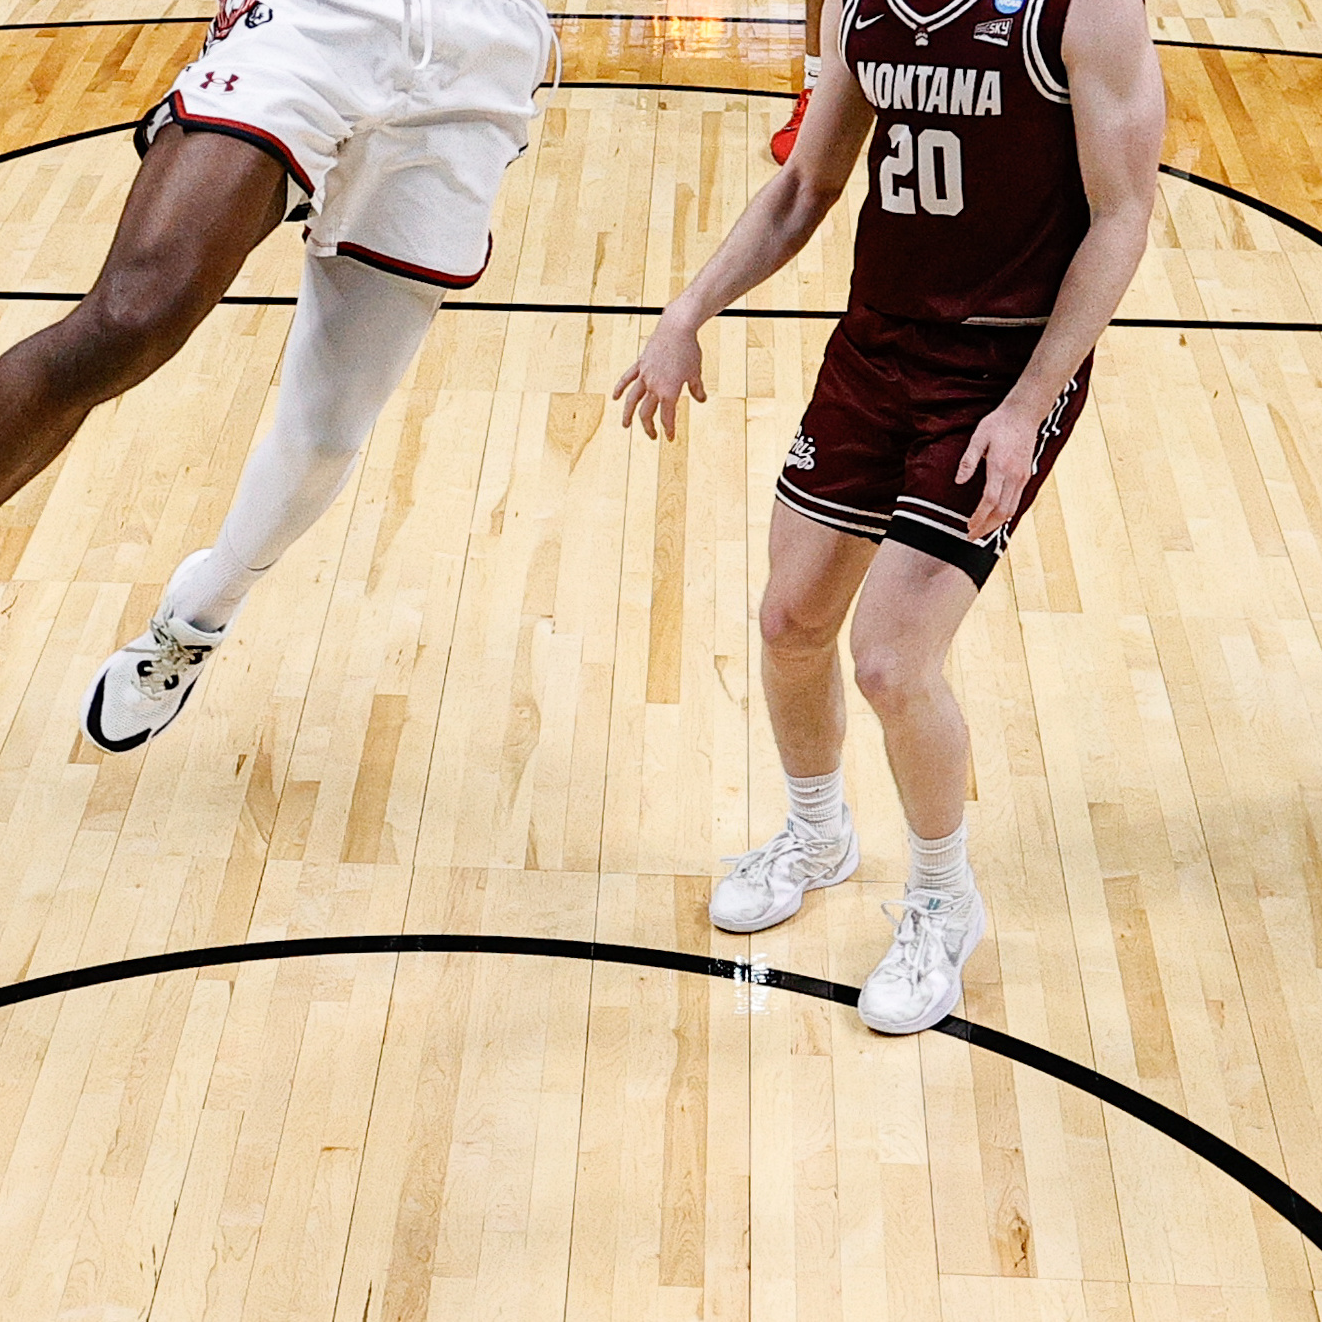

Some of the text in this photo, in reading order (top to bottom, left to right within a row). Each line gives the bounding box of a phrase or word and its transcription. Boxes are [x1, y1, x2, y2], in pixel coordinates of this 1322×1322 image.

[988, 20, 1009, 35] SKY
[856, 61, 1002, 116] MONTANA
[879, 123, 964, 217] 20
